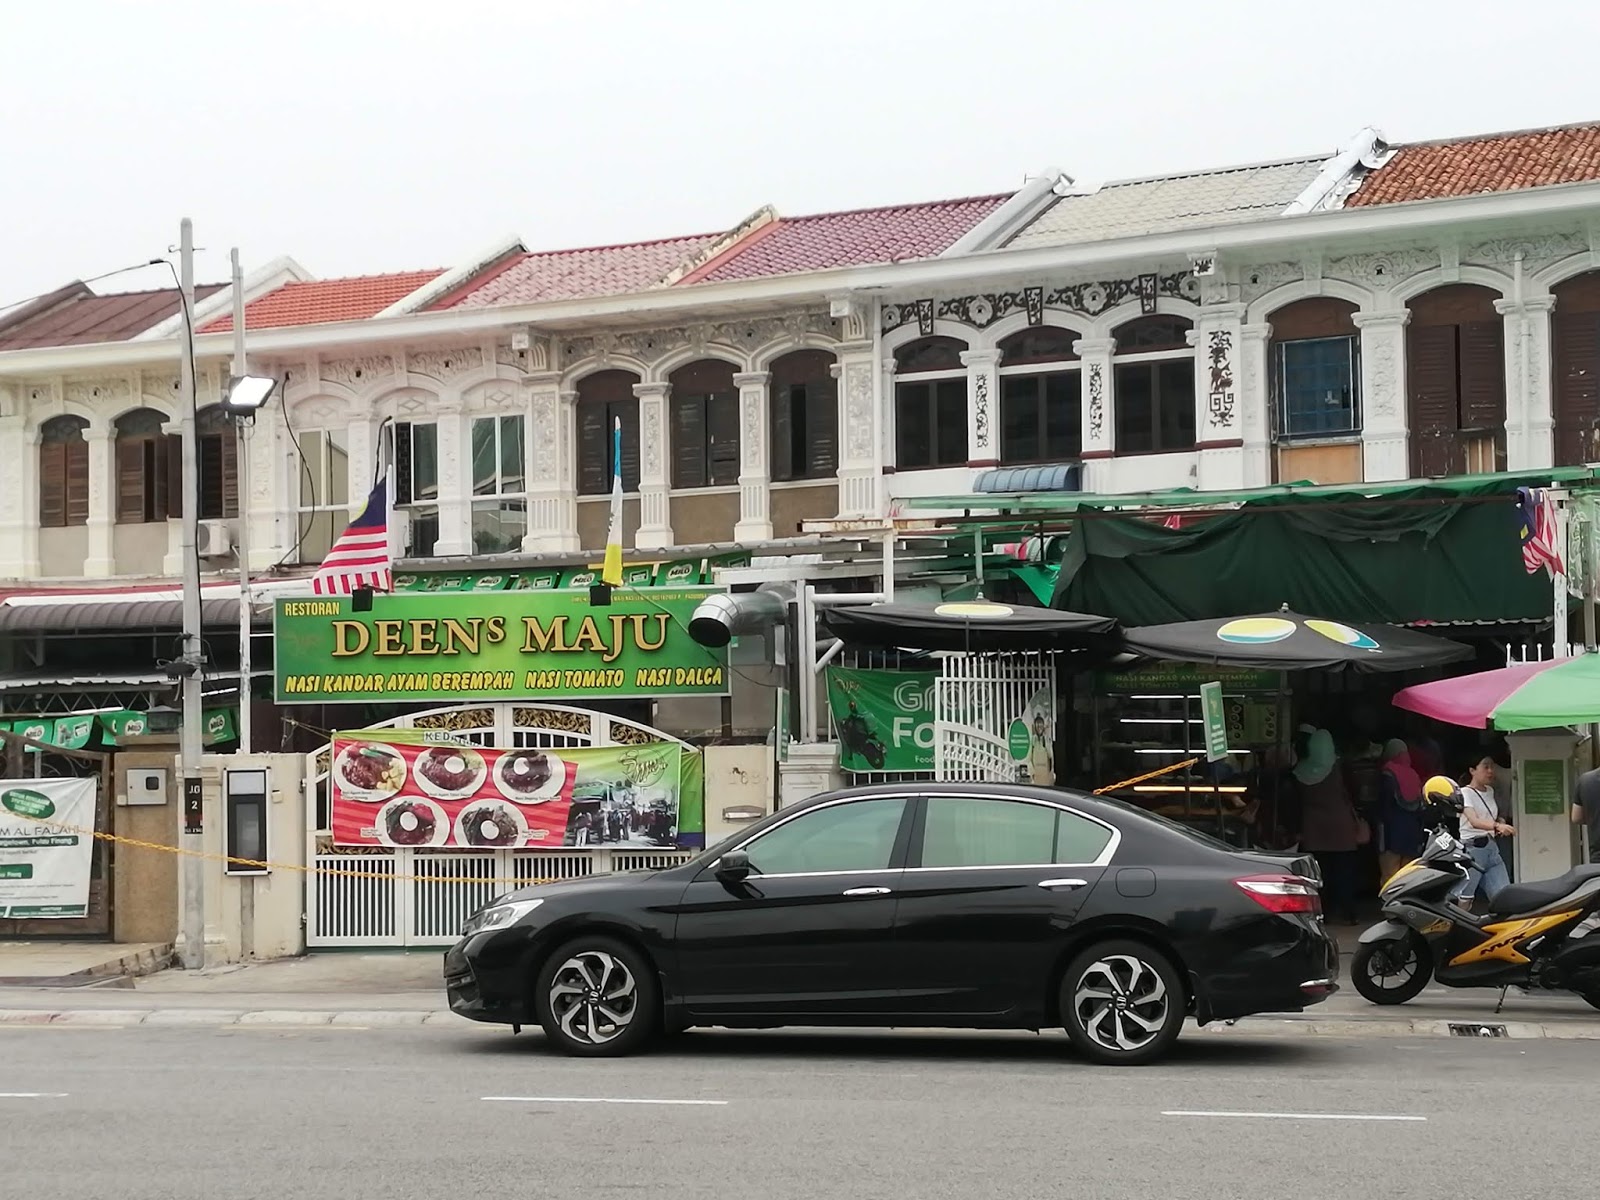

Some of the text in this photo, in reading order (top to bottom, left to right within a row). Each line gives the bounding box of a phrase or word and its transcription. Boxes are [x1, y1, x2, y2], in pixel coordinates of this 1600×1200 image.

[670, 567, 690, 576] MILO
[573, 576, 593, 584] MILO
[285, 602, 340, 616] RESTORAN
[520, 614, 671, 663] MAJU
[285, 666, 723, 694] NASI KANDAR AYAM BEREMPAH NASI TOMATO NASI DALCA
[1139, 674, 1178, 682] KANDAR
[191, 800, 198, 810] 2
[14, 826, 32, 837] AL
